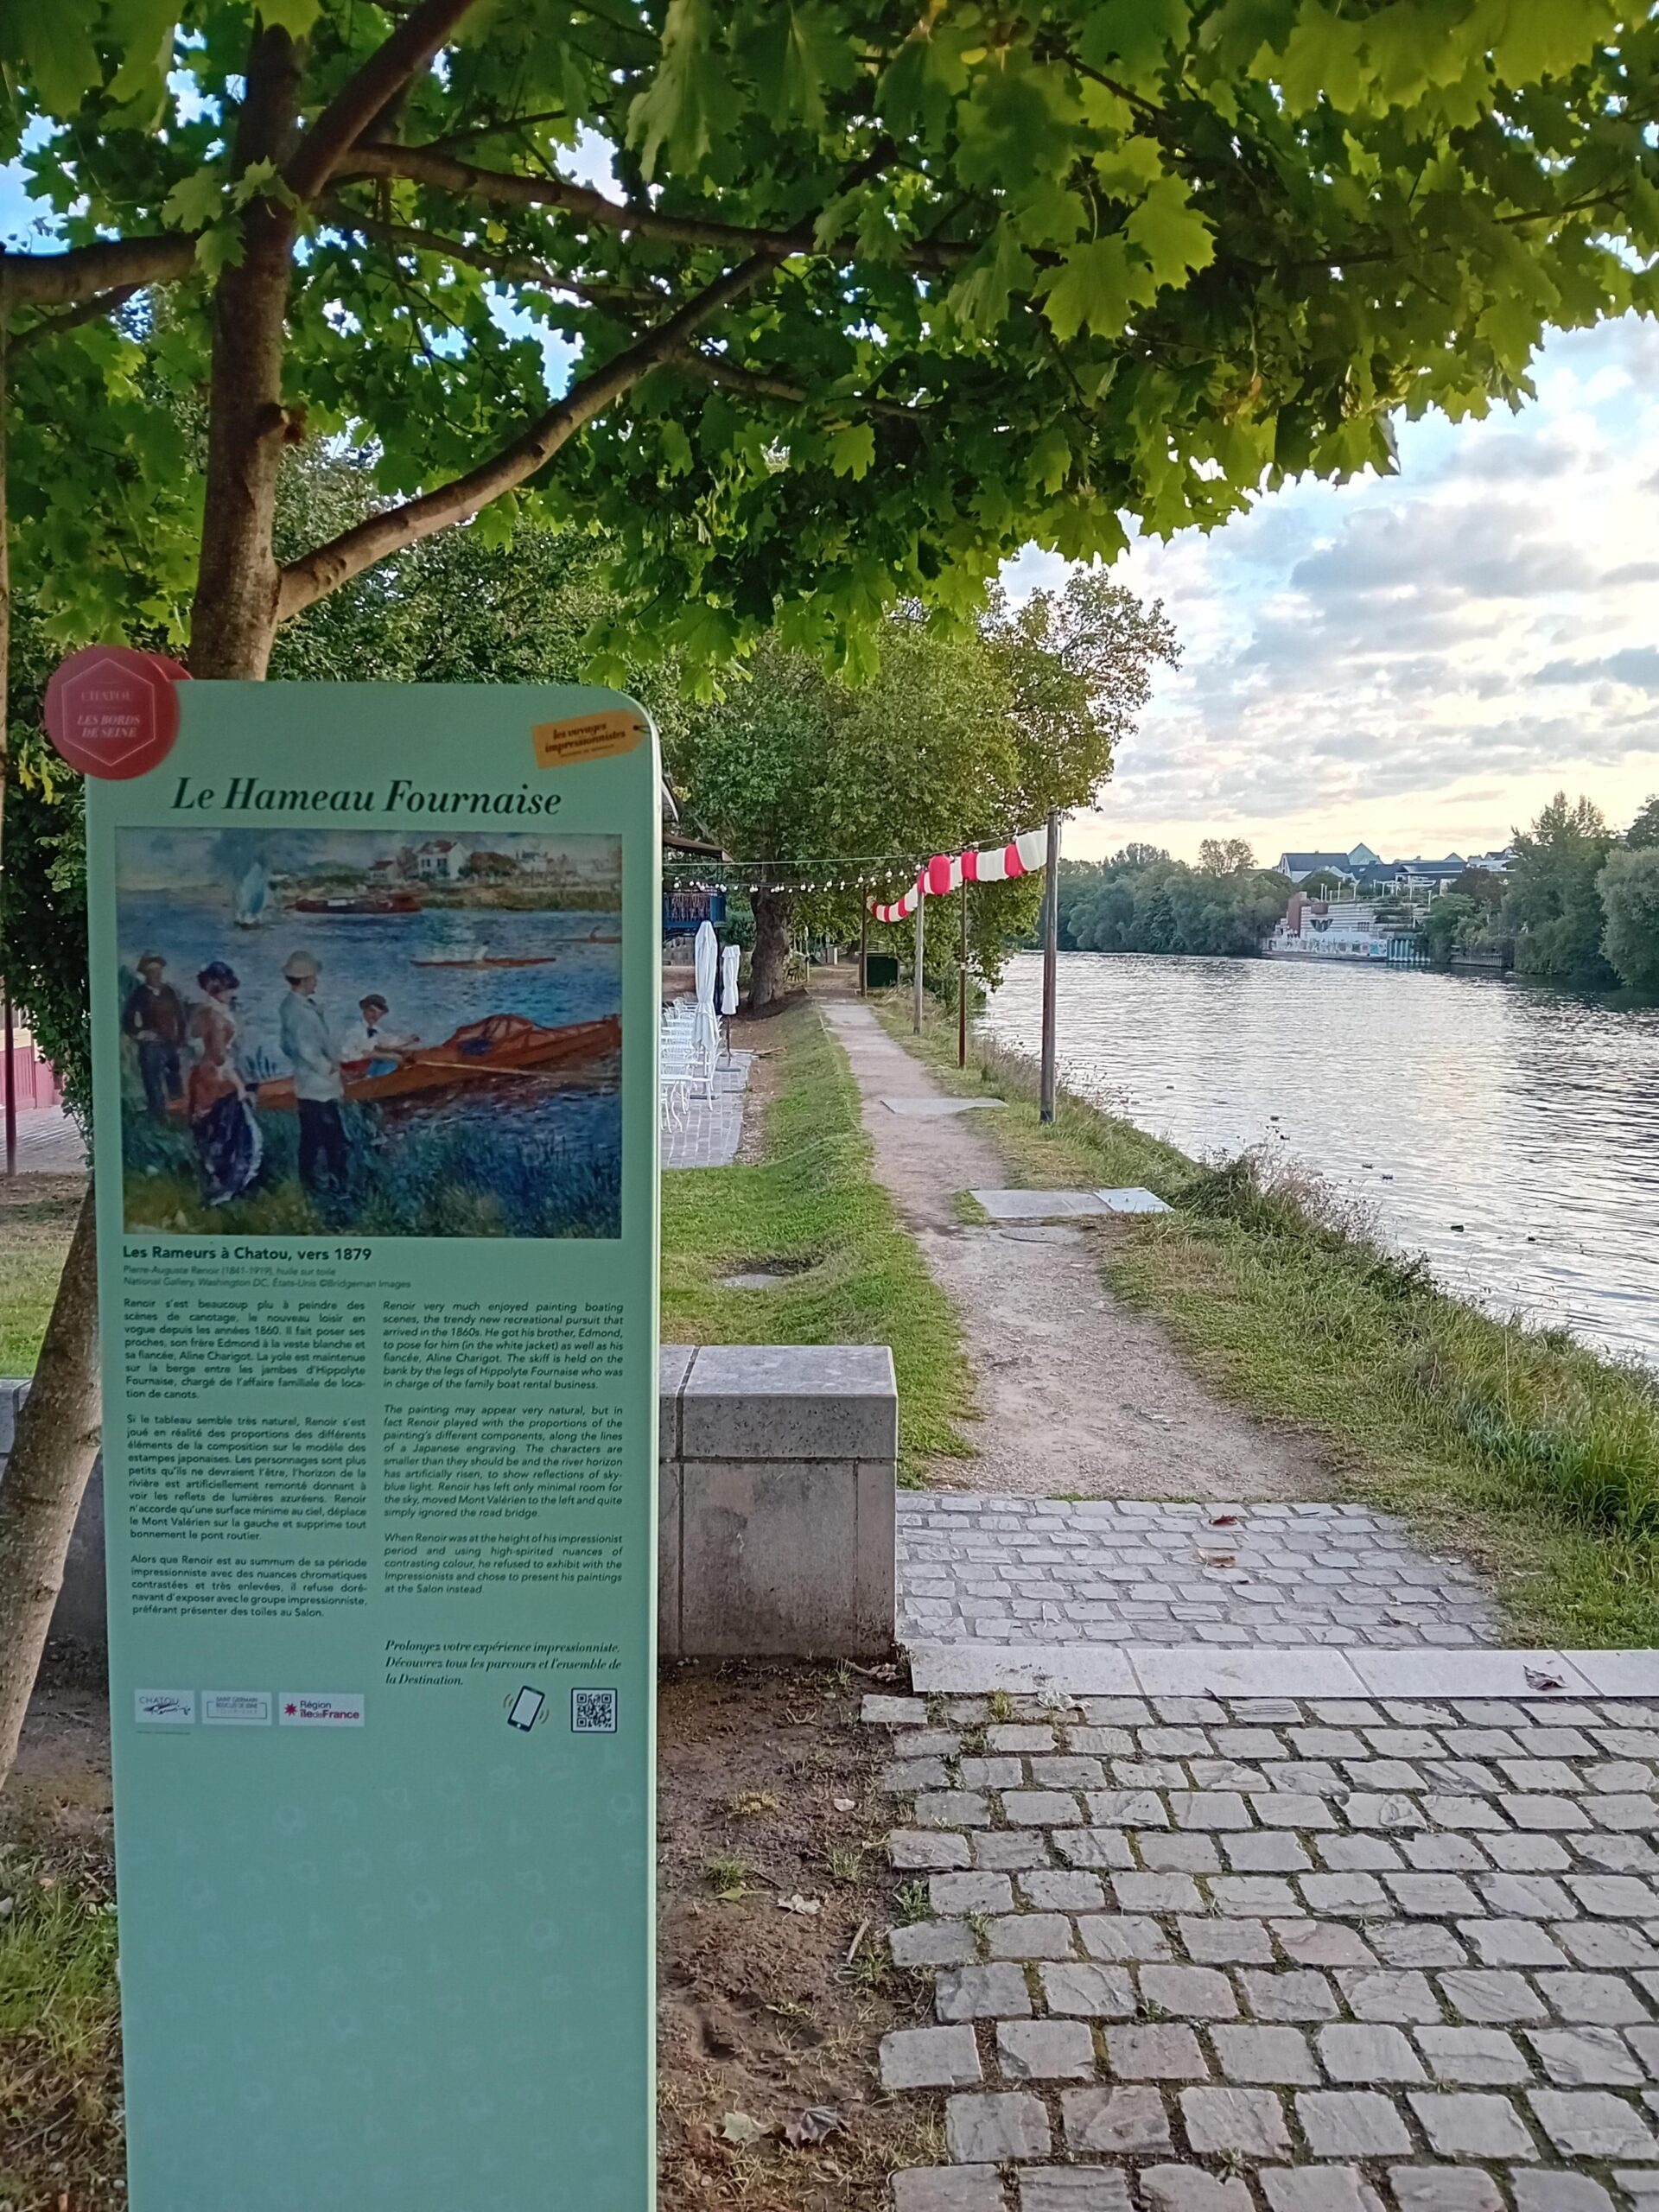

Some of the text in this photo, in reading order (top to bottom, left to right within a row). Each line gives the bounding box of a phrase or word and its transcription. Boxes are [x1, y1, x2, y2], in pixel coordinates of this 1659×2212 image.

[77, 715, 141, 726] LES BORDS
[82, 727, 137, 738] DE SEINE
[170, 778, 563, 816] Le Hameau Fournaise
[123, 1245, 372, 1261] Les Rameurs à Chatou, vers 1879
[124, 1298, 156, 1308] Renoir
[197, 1299, 248, 1312] beaucoup
[257, 1299, 273, 1312] plu
[283, 1300, 289, 1309] à
[297, 1300, 337, 1313] peindre
[346, 1300, 365, 1310] des
[383, 1300, 624, 1314] Renoir very much enjoyed painting boating
[423, 1313, 440, 1324] the
[443, 1313, 476, 1326] trendy
[503, 1314, 563, 1325] recreational
[564, 1314, 601, 1327] pursuit
[603, 1314, 624, 1325] that
[126, 1414, 136, 1424] Si
[140, 1414, 149, 1424] le
[154, 1414, 192, 1424] tableau
[196, 1414, 233, 1425] semble
[237, 1414, 257, 1425] très
[304, 1415, 337, 1426] Renoir
[127, 1426, 149, 1439] joué
[170, 1427, 202, 1437] réalité
[207, 1427, 226, 1437] des
[230, 1427, 289, 1440] proportions
[294, 1428, 313, 1438] des
[317, 1428, 365, 1439] différents
[385, 1531, 414, 1541] When
[415, 1532, 448, 1542] Renoir
[468, 1533, 479, 1542] at
[480, 1532, 497, 1542] the
[498, 1532, 531, 1545] height
[531, 1532, 543, 1542] of
[542, 1532, 556, 1542] his
[557, 1532, 622, 1545] impressionist
[384, 1544, 418, 1557] period
[426, 1545, 446, 1554] and
[454, 1545, 481, 1557] using
[611, 1545, 623, 1555] of
[130, 1554, 156, 1564] Alors
[159, 1556, 178, 1567] que
[181, 1554, 213, 1564] Renoir
[216, 1555, 232, 1565] est
[297, 1555, 311, 1566] de
[328, 1556, 366, 1568] période
[384, 1557, 440, 1570] contrasting
[477, 1558, 491, 1568] he
[493, 1558, 531, 1568] refused
[532, 1559, 543, 1568] to
[546, 1558, 580, 1568] exhibit
[582, 1558, 603, 1568] with
[606, 1558, 622, 1568] the
[131, 1567, 207, 1579] impressionniste
[236, 1567, 254, 1578] des
[300, 1568, 366, 1581] chromatiques
[384, 1570, 622, 1584] Impressionists and chose to present his paintings
[131, 1579, 188, 1589] contrastées
[195, 1580, 205, 1590] et
[212, 1580, 231, 1590] très
[290, 1580, 296, 1591] il
[302, 1581, 334, 1592] refuse
[384, 1584, 395, 1593] at
[397, 1583, 414, 1593] the
[416, 1583, 444, 1593] Salon
[131, 1592, 164, 1601] navant
[240, 1592, 249, 1603] le
[251, 1596, 286, 1605] groupe
[132, 1604, 178, 1617] préférant
[180, 1605, 227, 1618] présenter
[230, 1605, 248, 1616] des
[251, 1605, 276, 1616] toiles
[385, 1639, 441, 1655] Prolongez
[442, 1642, 471, 1651] votre
[472, 1641, 531, 1656] expérience
[385, 1656, 442, 1668] Découvrez
[444, 1658, 467, 1669] tous
[469, 1656, 485, 1668] les
[486, 1661, 537, 1672] parcours
[538, 1659, 549, 1669] et
[607, 1658, 621, 1669] de
[385, 1673, 397, 1684] la
[300, 1700, 332, 1710] Région
